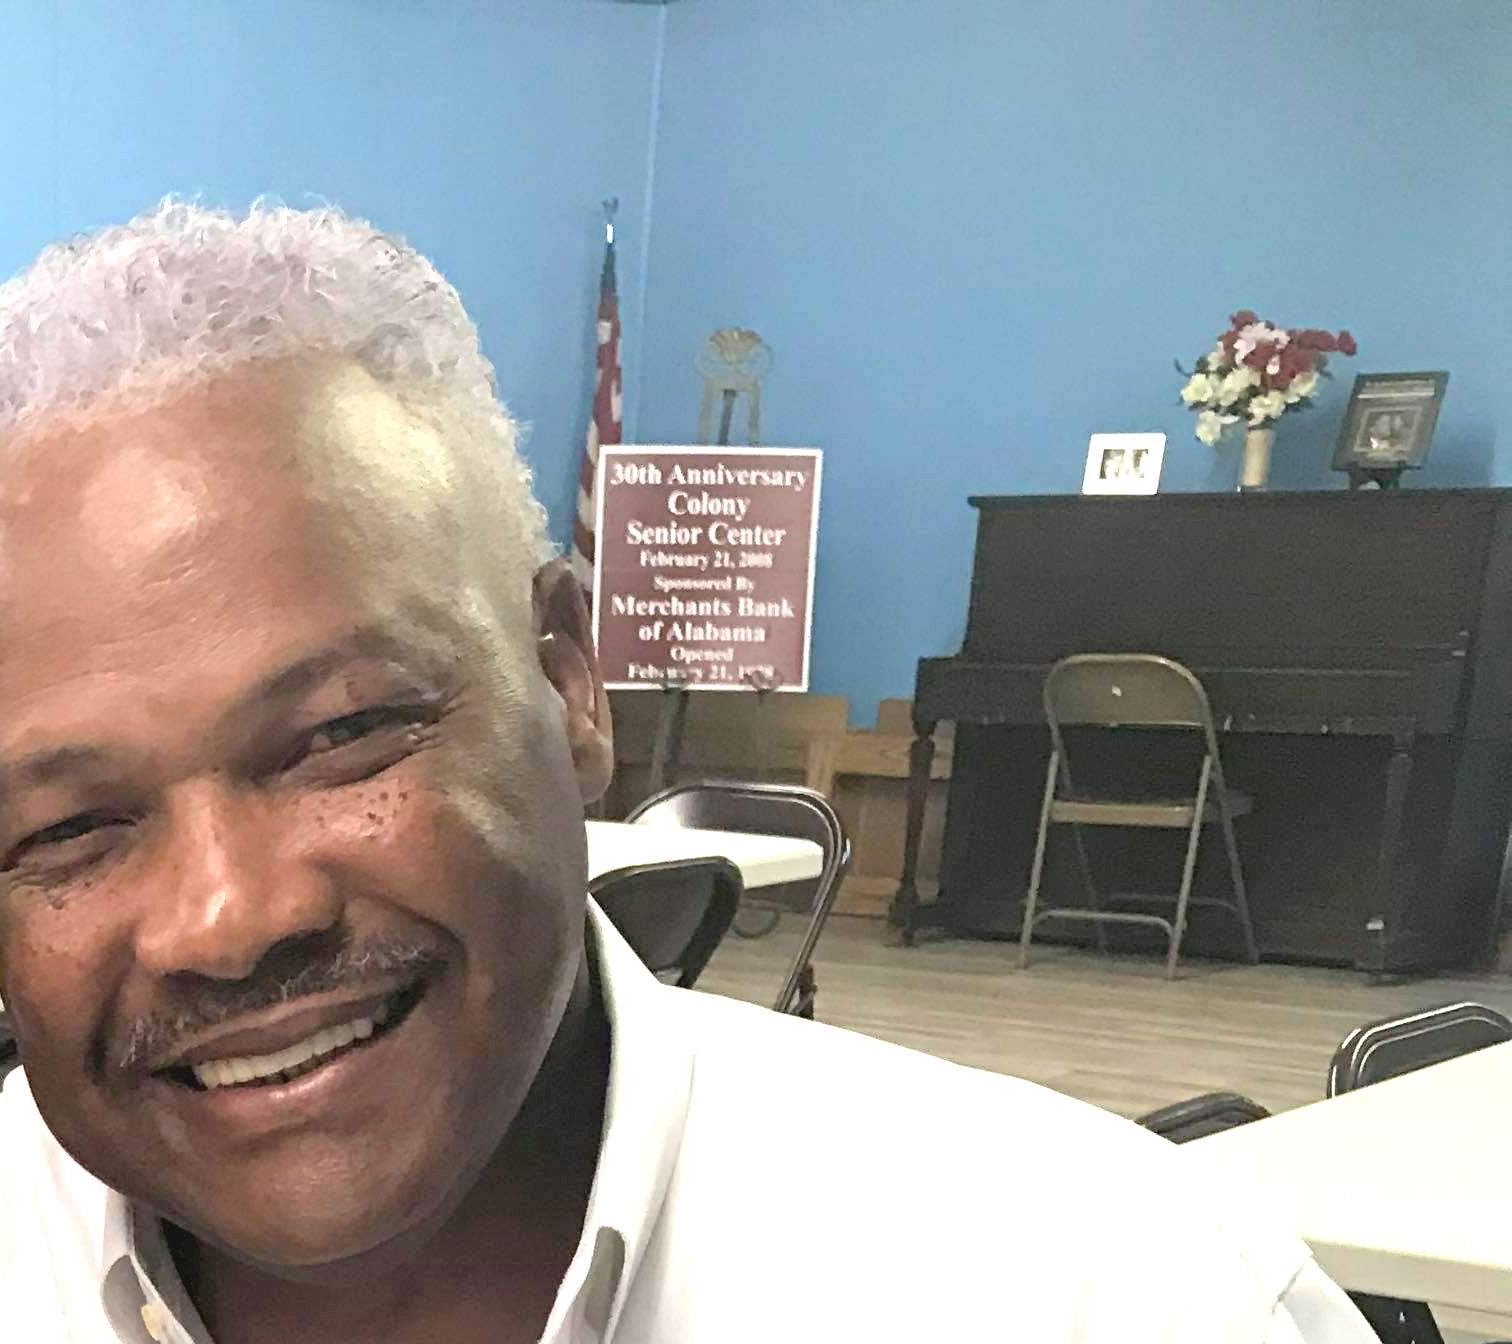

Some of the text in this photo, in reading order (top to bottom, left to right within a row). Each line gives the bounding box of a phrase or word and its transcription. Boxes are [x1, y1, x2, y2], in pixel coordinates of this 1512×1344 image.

[610, 463, 809, 491] 30th Anniversary
[667, 490, 751, 521] Colony
[626, 519, 787, 546] Senior Center
[640, 550, 708, 571] February
[713, 551, 735, 569] 21,
[653, 576, 755, 593] Sponsored By
[611, 596, 795, 618] Merchants Bank
[638, 621, 766, 643] of Alabama
[670, 646, 734, 664] Opened
